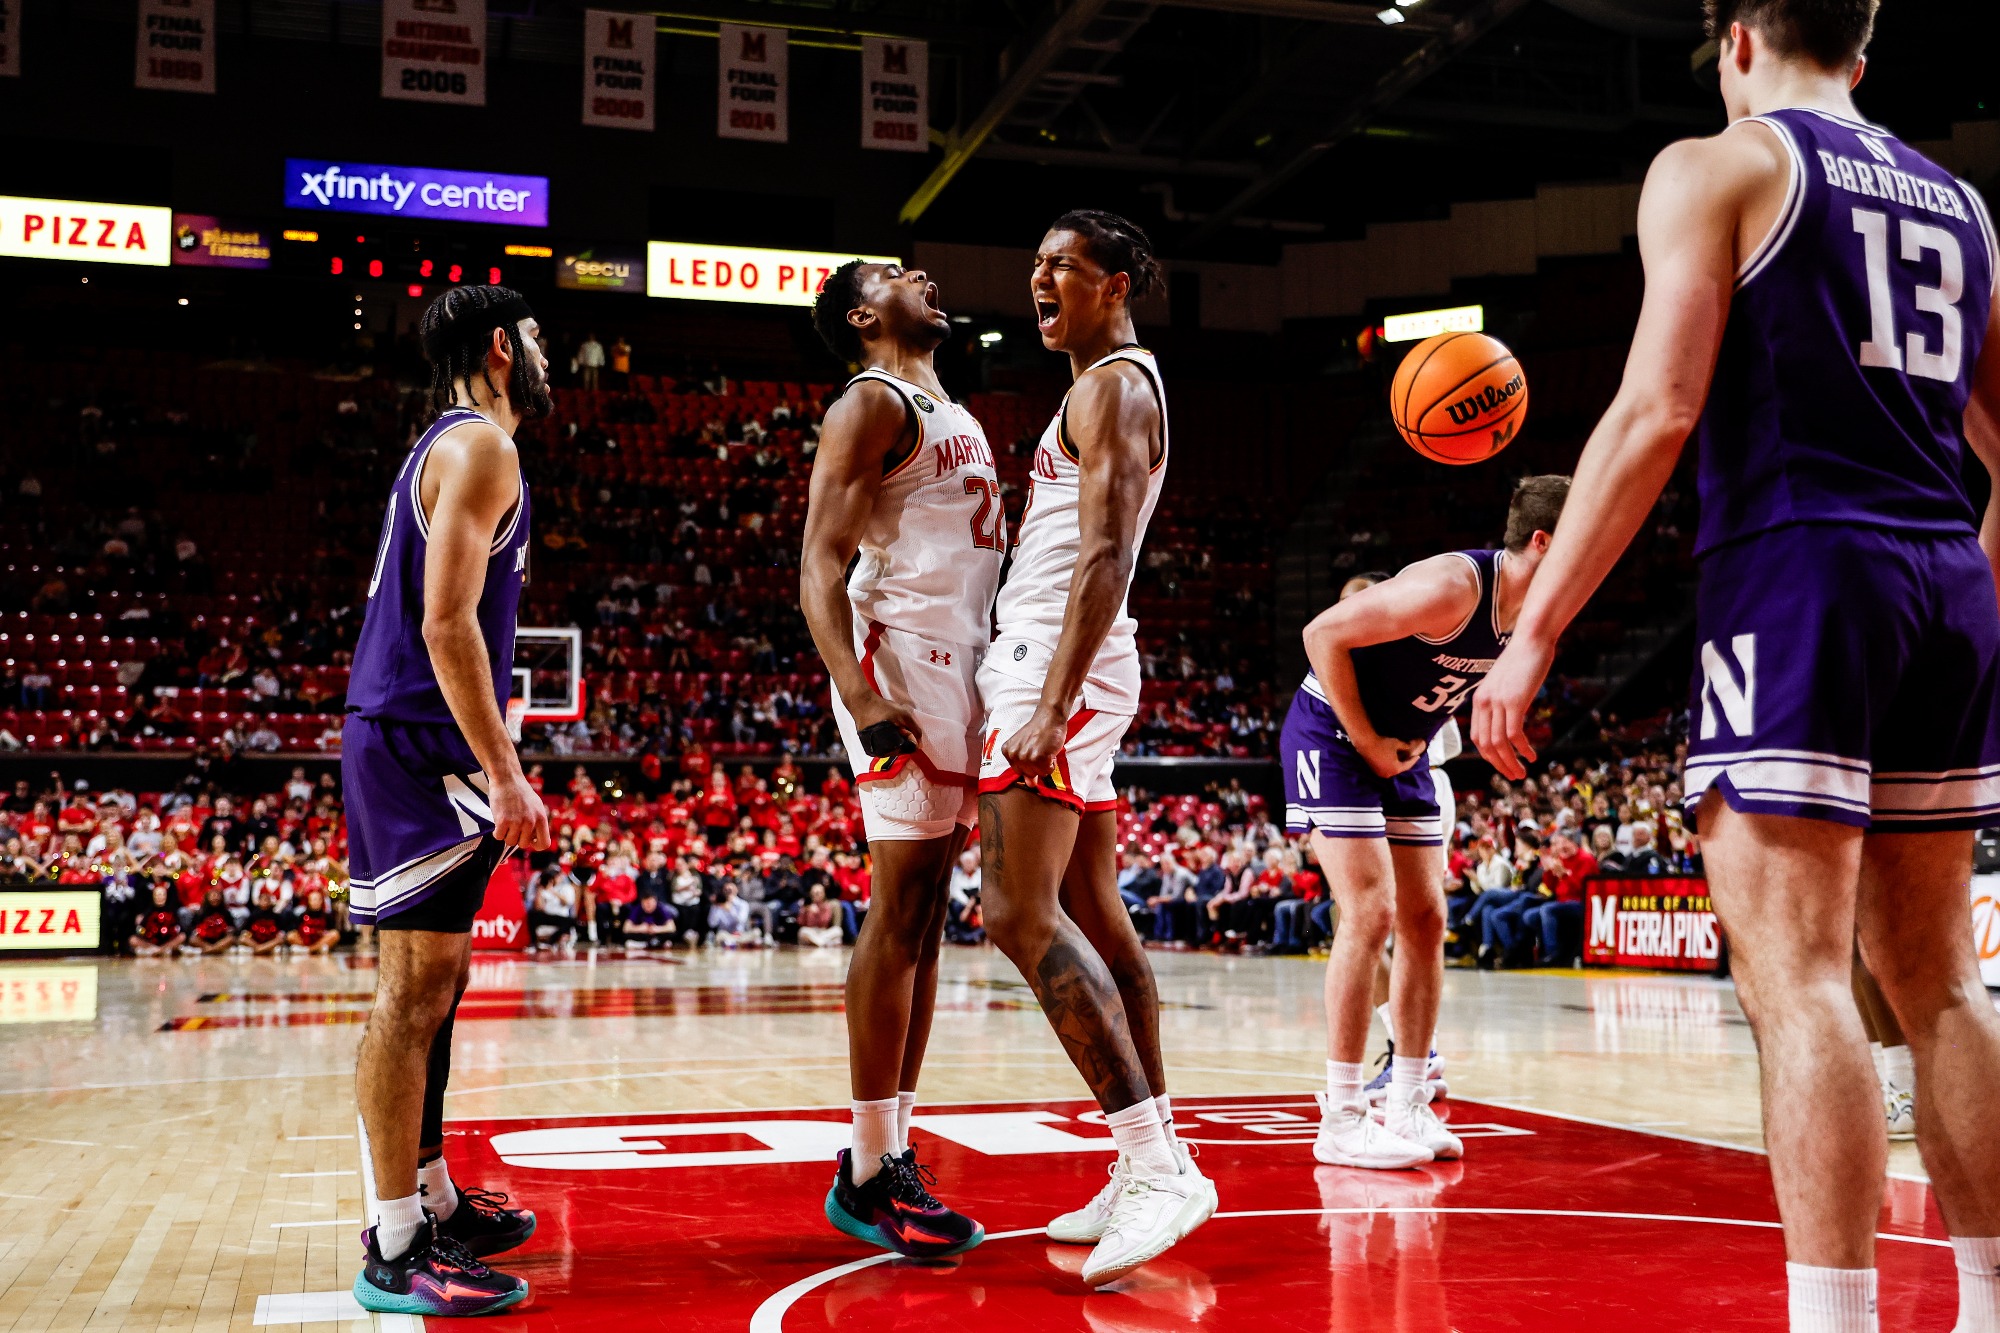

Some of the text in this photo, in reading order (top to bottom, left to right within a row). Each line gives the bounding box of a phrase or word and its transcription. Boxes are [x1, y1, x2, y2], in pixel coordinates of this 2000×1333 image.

[149, 15, 205, 34] FINAL
[608, 18, 633, 49] M
[150, 33, 202, 50] FOUR
[741, 31, 766, 62] M
[593, 56, 645, 75] FINAL
[883, 45, 908, 74] M
[402, 69, 467, 94] 2006
[595, 73, 642, 90] FOUR
[728, 69, 778, 87] FINAL
[870, 82, 918, 98] FINAL
[731, 86, 776, 103] FOUR
[873, 98, 917, 113] FOUR
[730, 110, 775, 130] 2014
[301, 166, 531, 212] xfinity center
[1816, 149, 1969, 223] BARNHIZER
[24, 214, 146, 250] PIZZA
[574, 260, 629, 278] secu
[669, 258, 831, 293] LEDO PIZ
[1851, 207, 1963, 383] 13
[1444, 374, 1524, 425] Wilson
[934, 434, 996, 478] MARYL
[1411, 674, 1482, 714] 34
[1701, 633, 1754, 741] N
[1297, 749, 1320, 799] N
[1622, 895, 1658, 911] HOME
[1663, 895, 1682, 911] OF
[0, 909, 82, 934] IZZA
[471, 914, 522, 944] nity
[1589, 894, 1618, 947] M
[1617, 911, 1719, 959] TERRAPINS
